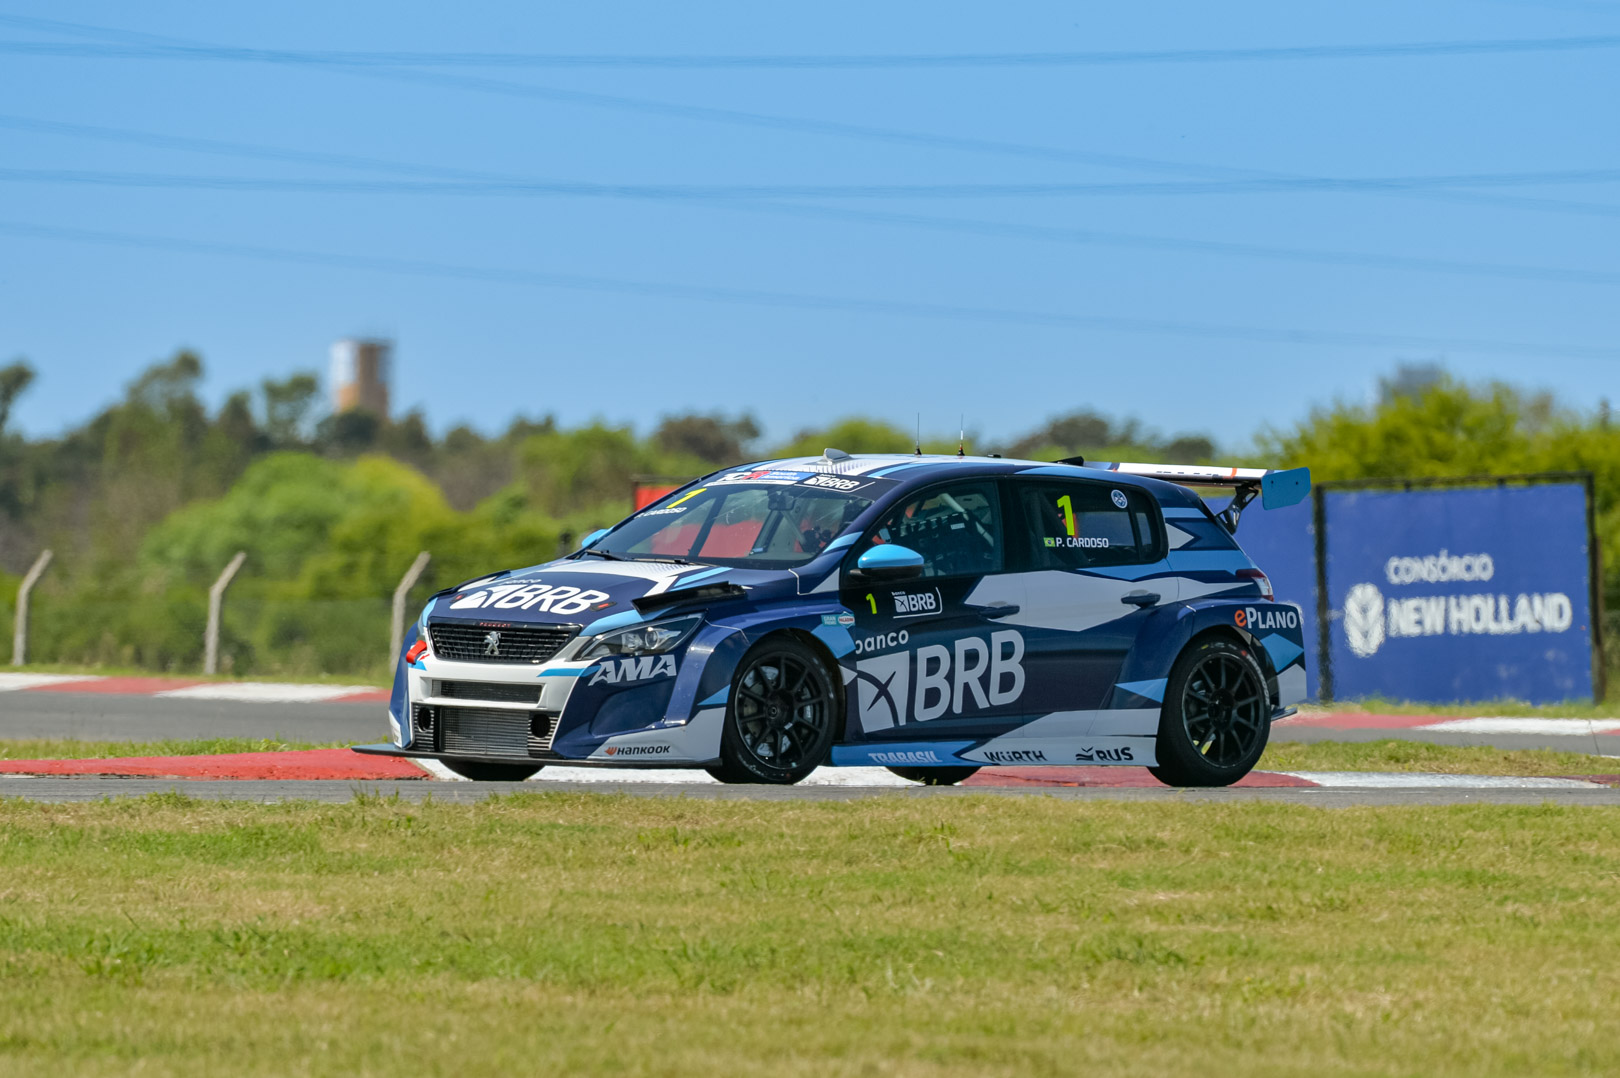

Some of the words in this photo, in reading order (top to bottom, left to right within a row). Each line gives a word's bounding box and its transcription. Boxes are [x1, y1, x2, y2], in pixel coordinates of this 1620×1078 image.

[819, 477, 861, 490] BRB
[665, 487, 707, 509] 1
[1056, 494, 1075, 536] 1
[1055, 537, 1065, 548] P.
[1066, 537, 1109, 548] CARDOSO
[494, 584, 610, 615] BRB
[865, 593, 878, 615] 1
[908, 592, 937, 612] BRB
[1388, 596, 1446, 637] NEW
[1449, 591, 1573, 635] HOLLAND
[588, 654, 677, 687] AMA
[914, 629, 1026, 722] BRB
[868, 750, 943, 763] TRABASIL
[1096, 746, 1135, 762] RUS
